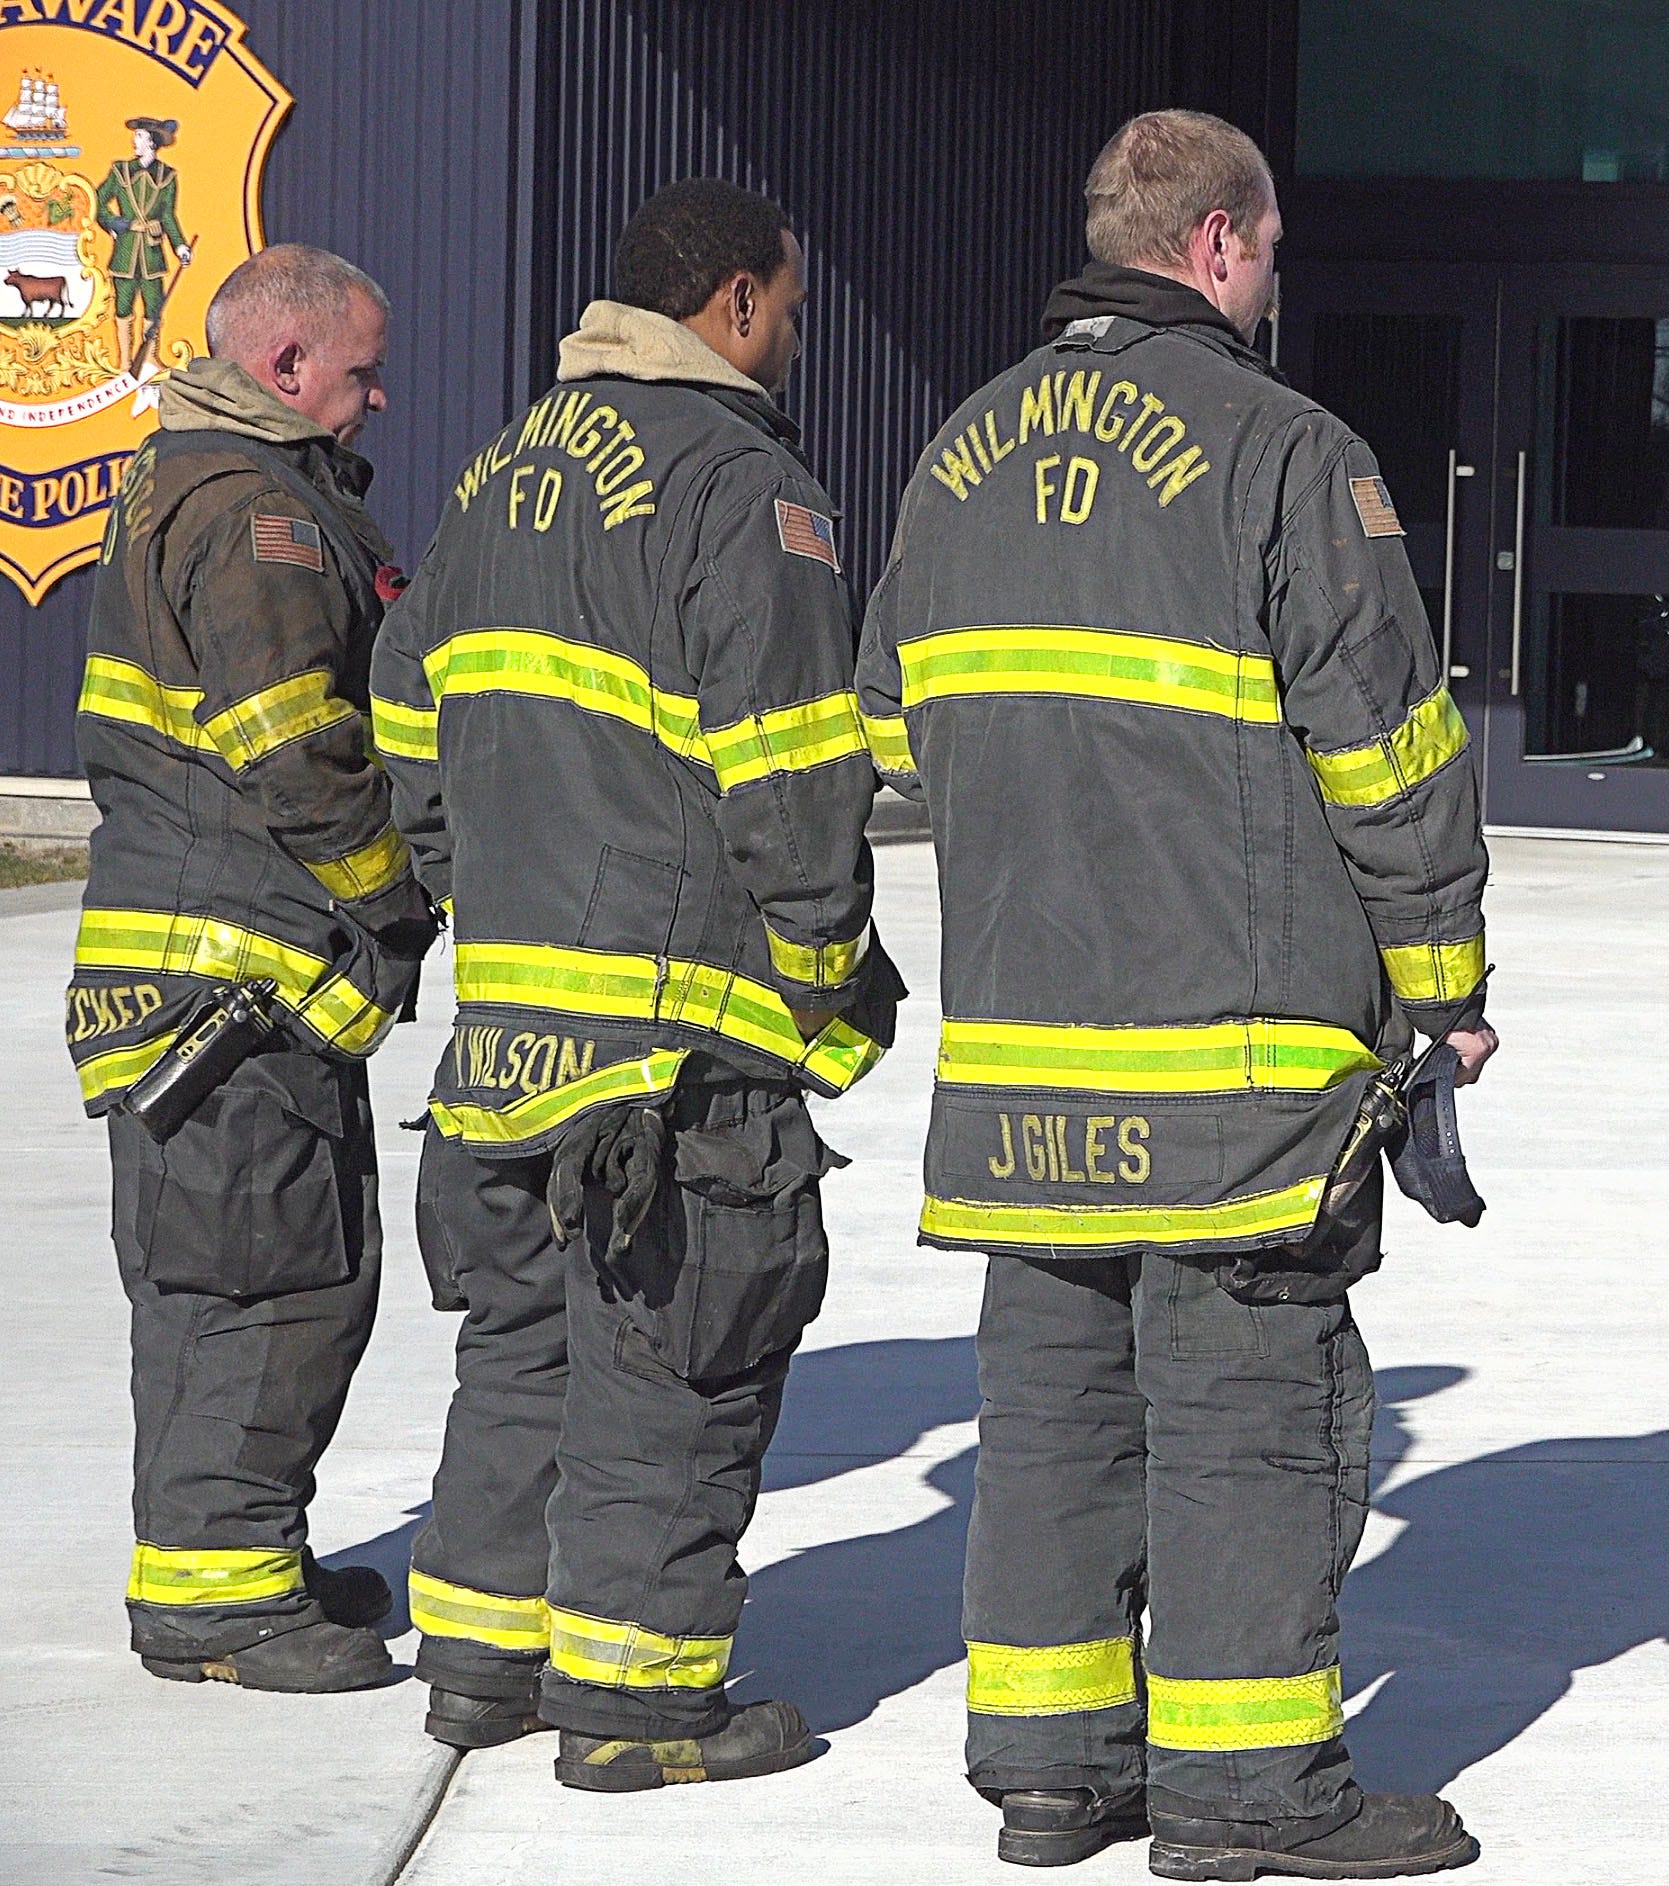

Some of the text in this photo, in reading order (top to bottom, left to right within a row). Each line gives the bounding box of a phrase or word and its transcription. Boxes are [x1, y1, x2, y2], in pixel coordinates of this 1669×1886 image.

[22, 378, 130, 422] INDEPENDENCE
[454, 390, 656, 532] WILMINGTON
[930, 370, 1212, 508] WILMINGTON
[31, 456, 134, 522] POLI
[508, 464, 563, 533] FD
[1035, 453, 1100, 525] FD
[467, 1026, 596, 1094] WILSON
[988, 1113, 1151, 1184] J GILES
